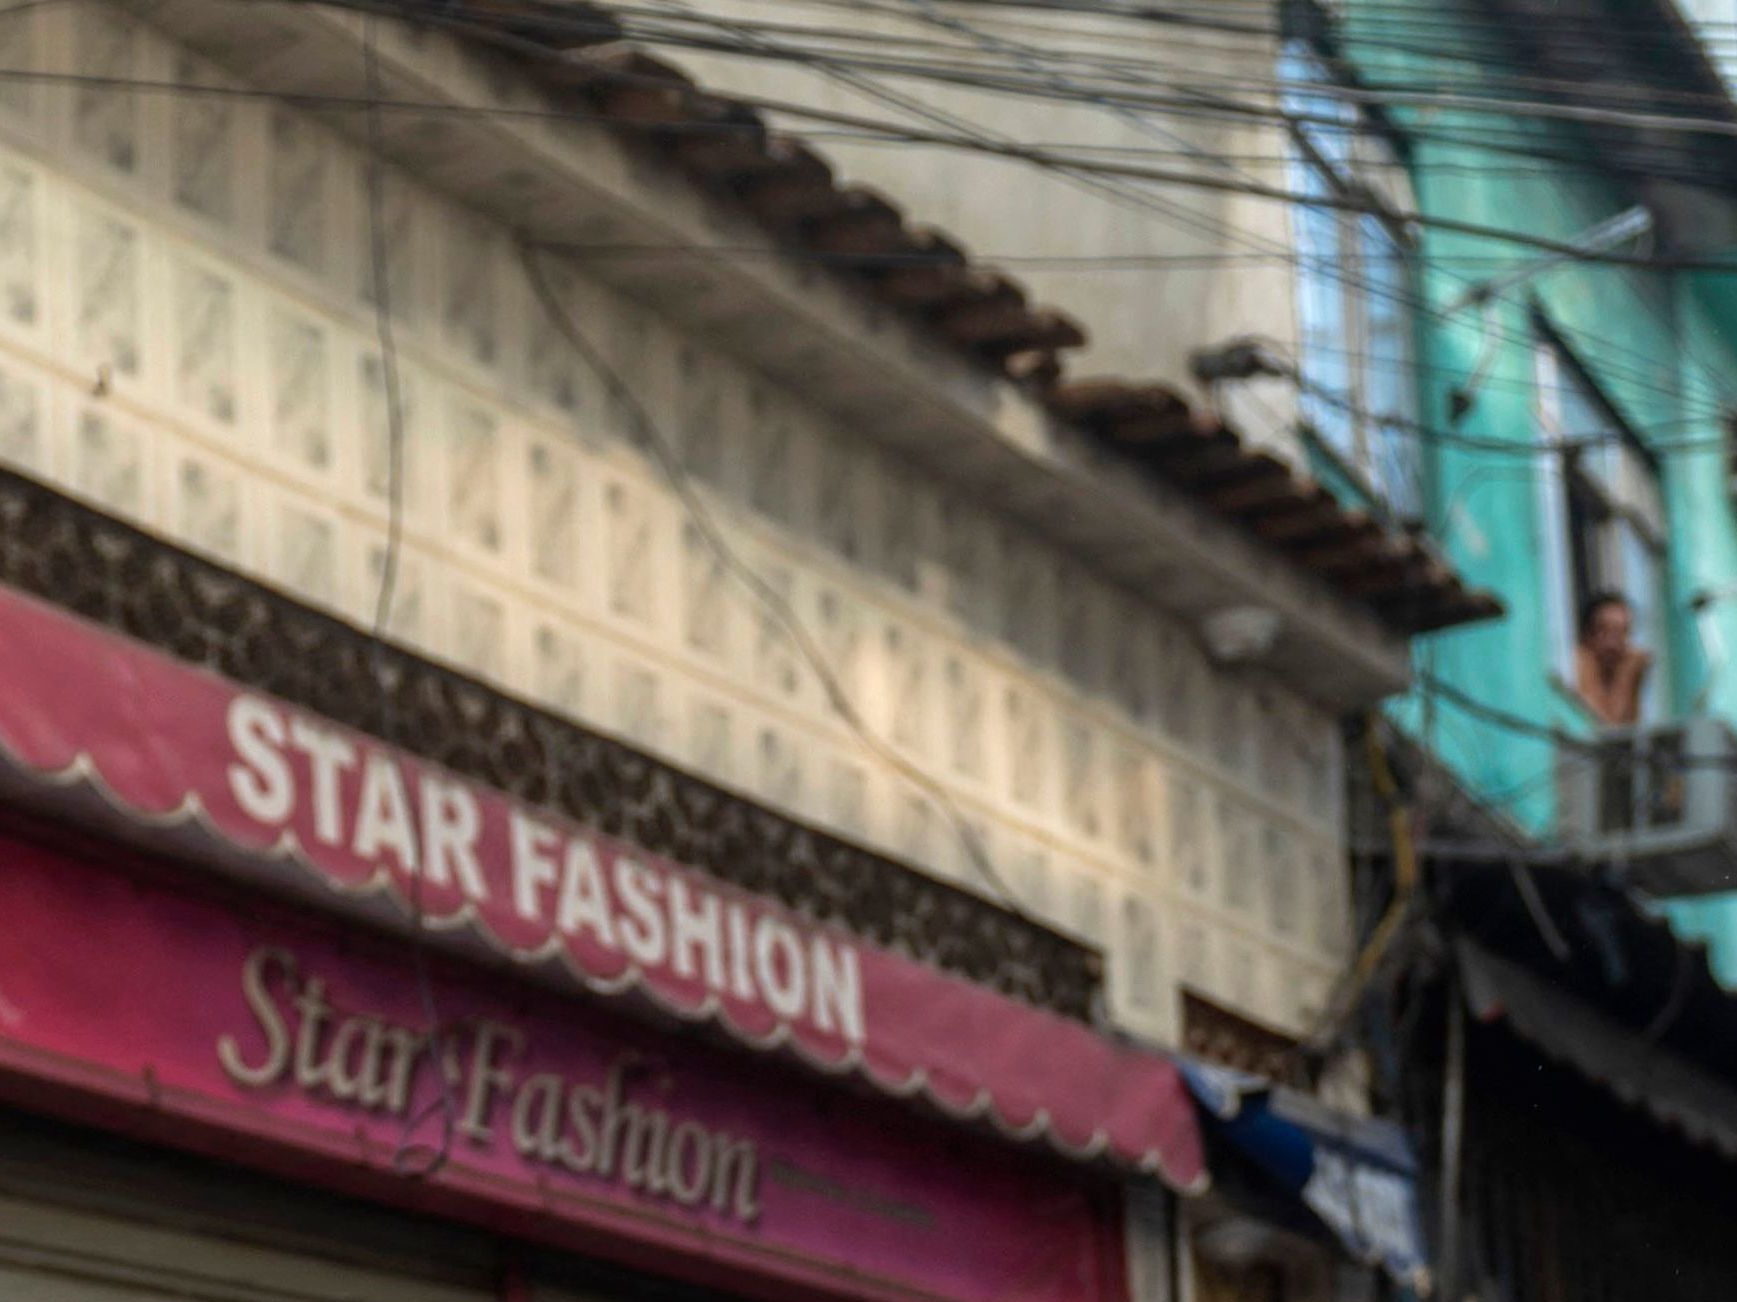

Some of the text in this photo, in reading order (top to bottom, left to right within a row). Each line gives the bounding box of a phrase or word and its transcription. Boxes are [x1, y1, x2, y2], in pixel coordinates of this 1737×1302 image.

[225, 694, 867, 1045] STAR FASHION
[216, 946, 432, 1113] Star
[442, 1018, 761, 1222] Fashion
